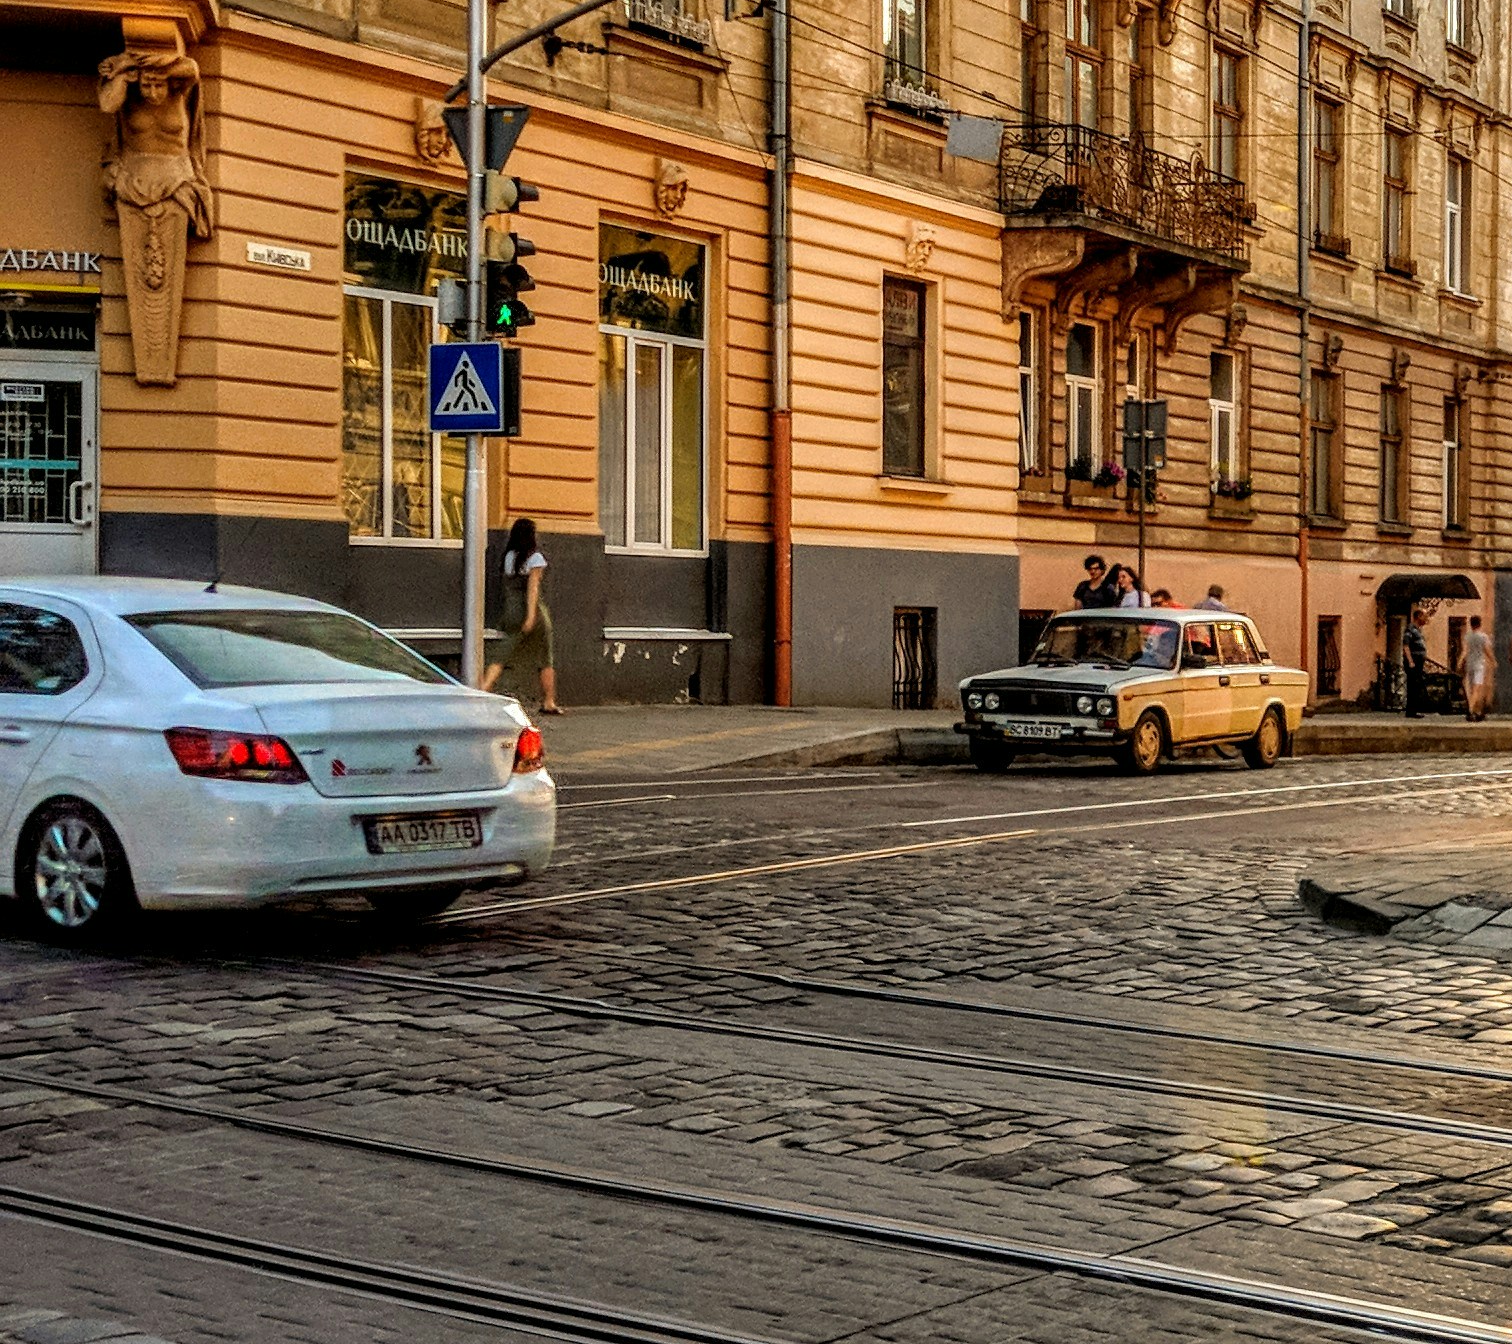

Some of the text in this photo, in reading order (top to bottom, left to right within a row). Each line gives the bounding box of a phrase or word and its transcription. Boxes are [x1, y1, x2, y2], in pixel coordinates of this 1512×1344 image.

[346, 217, 468, 258] ОЩАДБАНК
[0, 248, 102, 272] ДБАНК
[598, 262, 696, 302] ОЩАДБАНК
[408, 821, 446, 842] 0317
